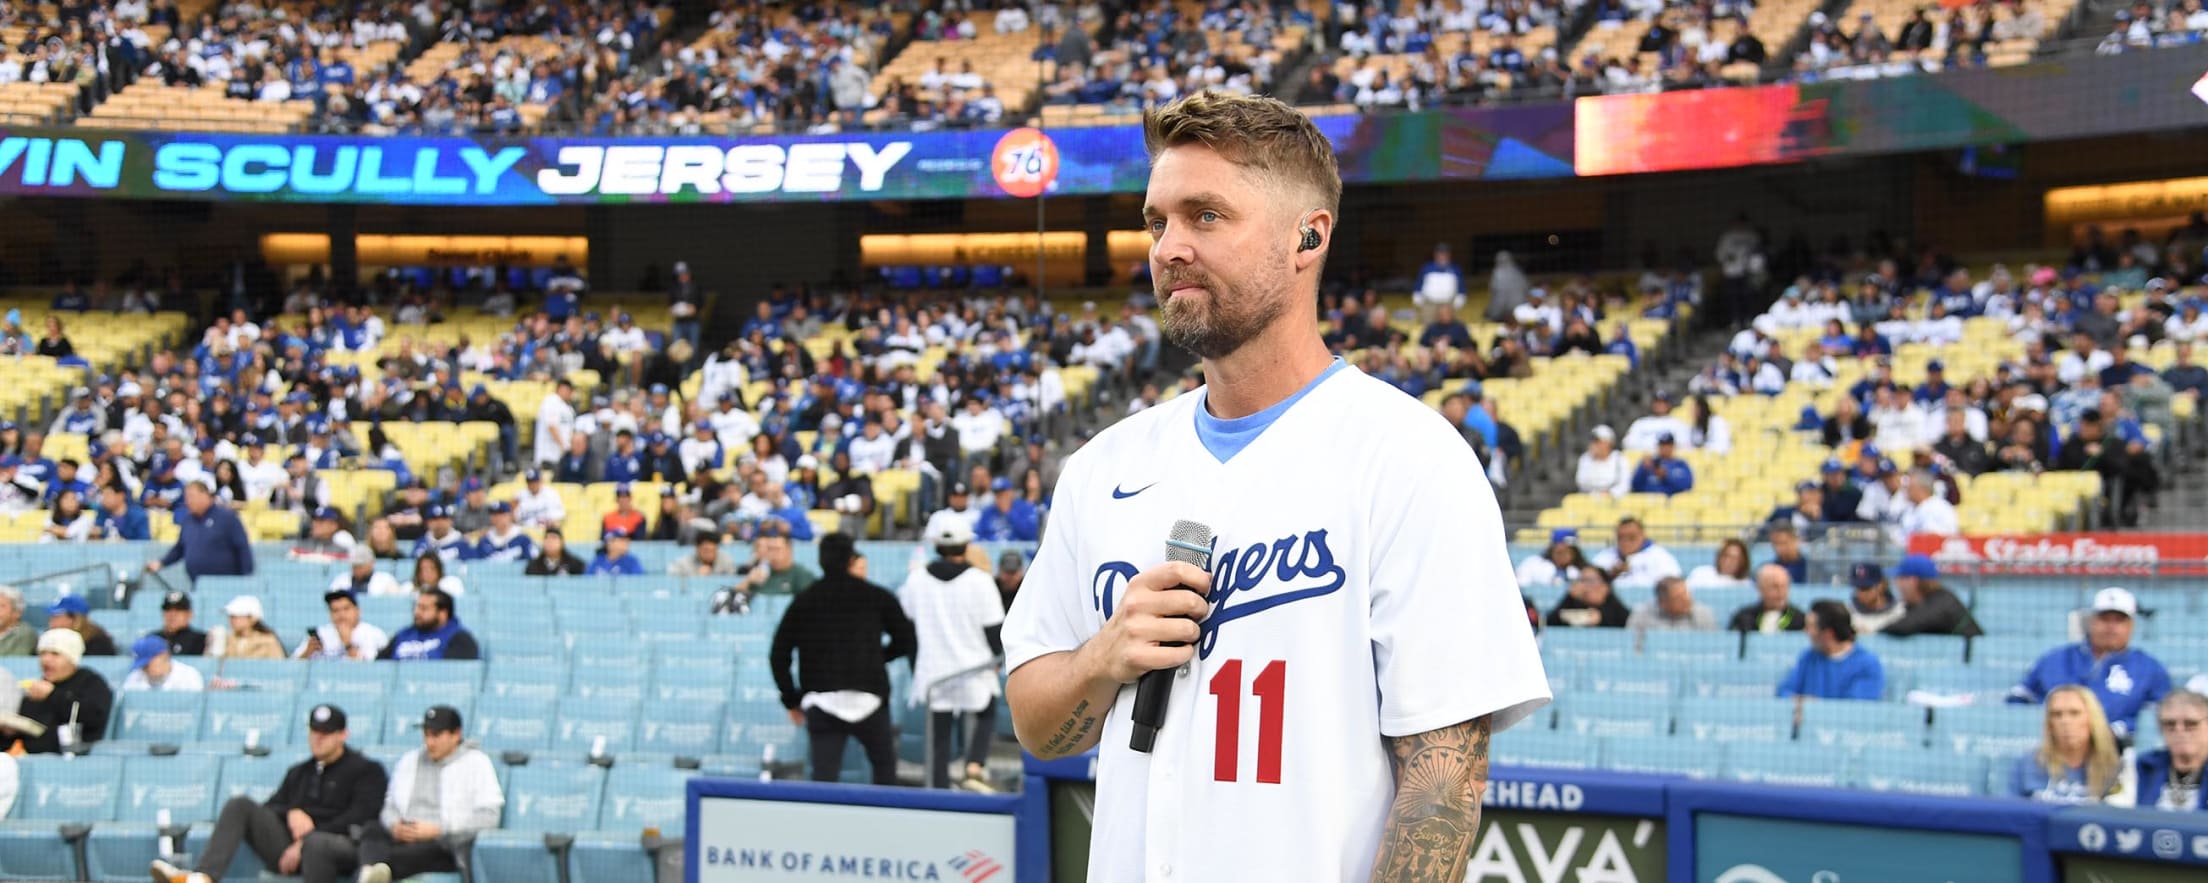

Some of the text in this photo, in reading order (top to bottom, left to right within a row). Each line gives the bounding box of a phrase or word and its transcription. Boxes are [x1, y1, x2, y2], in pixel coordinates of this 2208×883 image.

[154, 143, 526, 195] SCULLY
[537, 141, 912, 195] JERSEY
[1002, 143, 1048, 183] 76
[1093, 528, 1346, 661] Dgers
[1209, 659, 1286, 785] 11
[706, 846, 940, 882] BANK OF AMERICA
